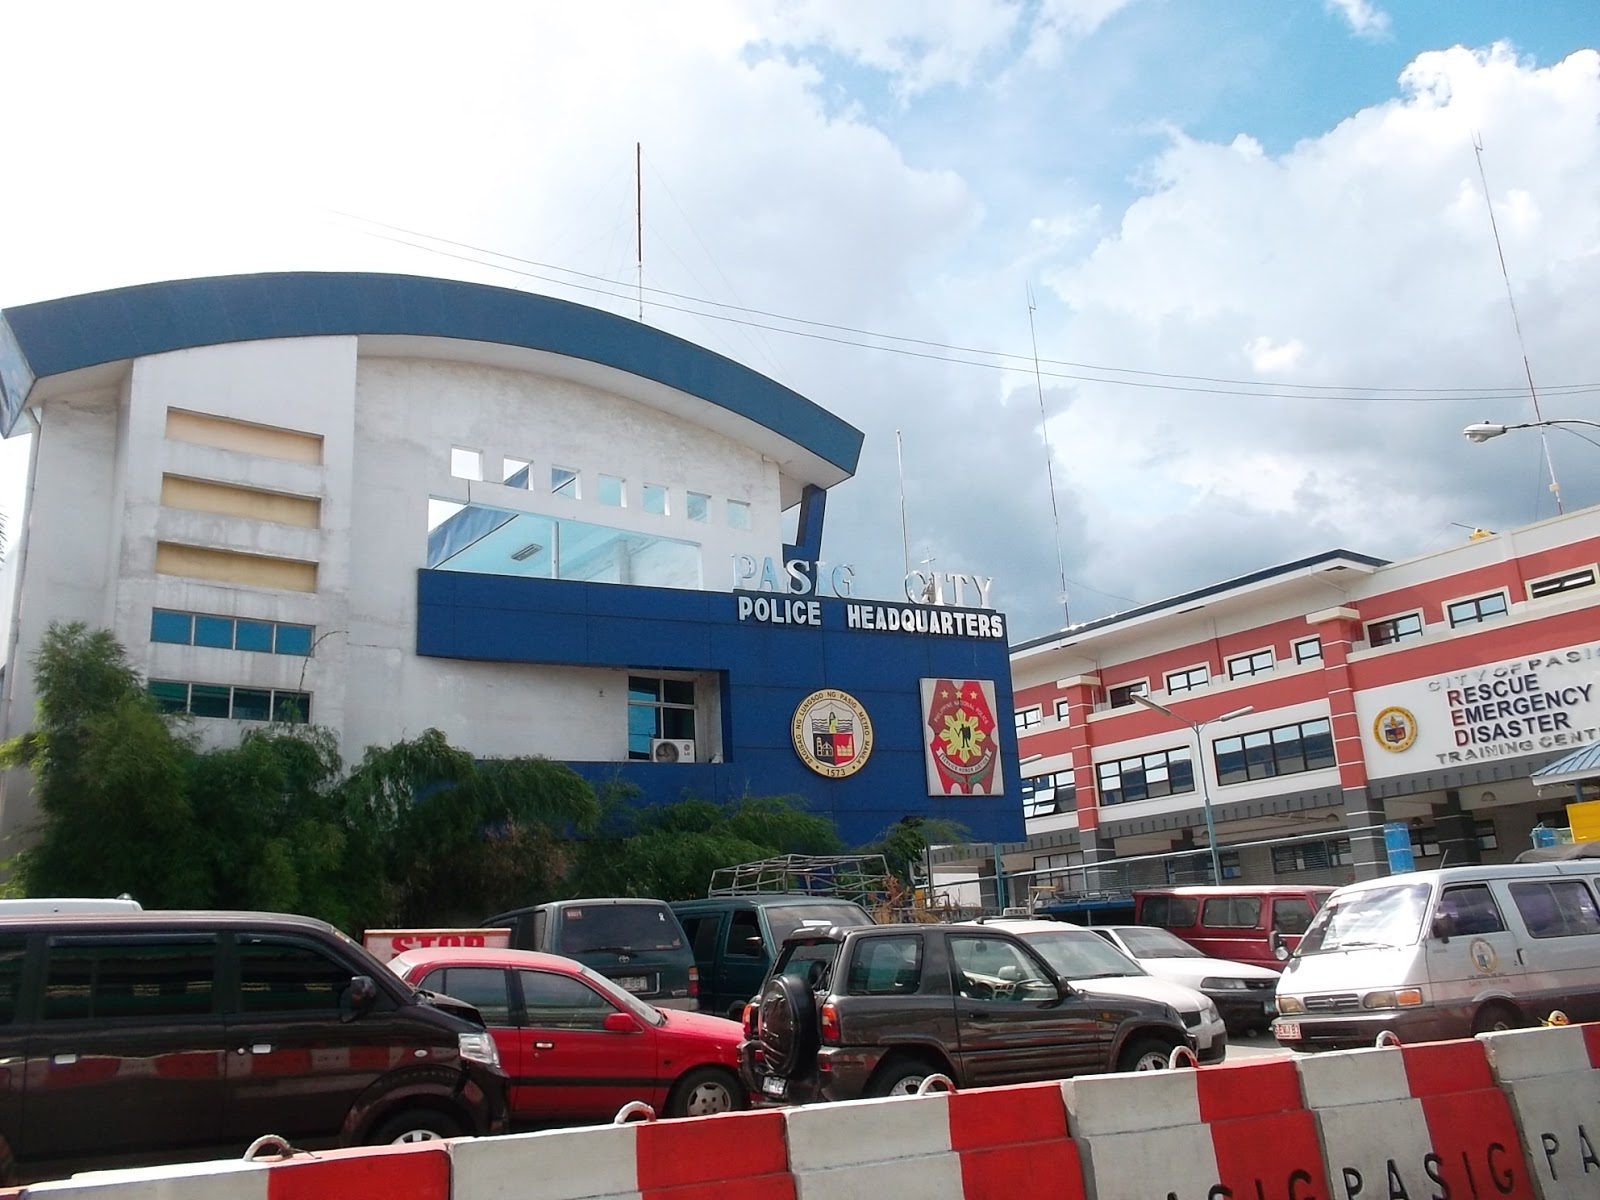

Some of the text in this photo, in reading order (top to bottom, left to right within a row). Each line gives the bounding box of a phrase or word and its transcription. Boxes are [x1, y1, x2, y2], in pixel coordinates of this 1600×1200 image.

[731, 554, 994, 608] PASIG CITY
[738, 596, 1003, 638] POLICE HEADQUARTERS
[1428, 670, 1487, 691] CITY
[1493, 662, 1522, 677] OF
[1447, 674, 1540, 707] RESCUE
[800, 692, 824, 716] LUNGSOD
[839, 694, 858, 709] PASIG
[1451, 684, 1592, 726] EMERGENCY
[1436, 728, 1600, 764] TRAINING CENT
[1454, 712, 1571, 746] DISASTER
[826, 768, 846, 777] 1573
[1342, 1142, 1514, 1200] PASIG
